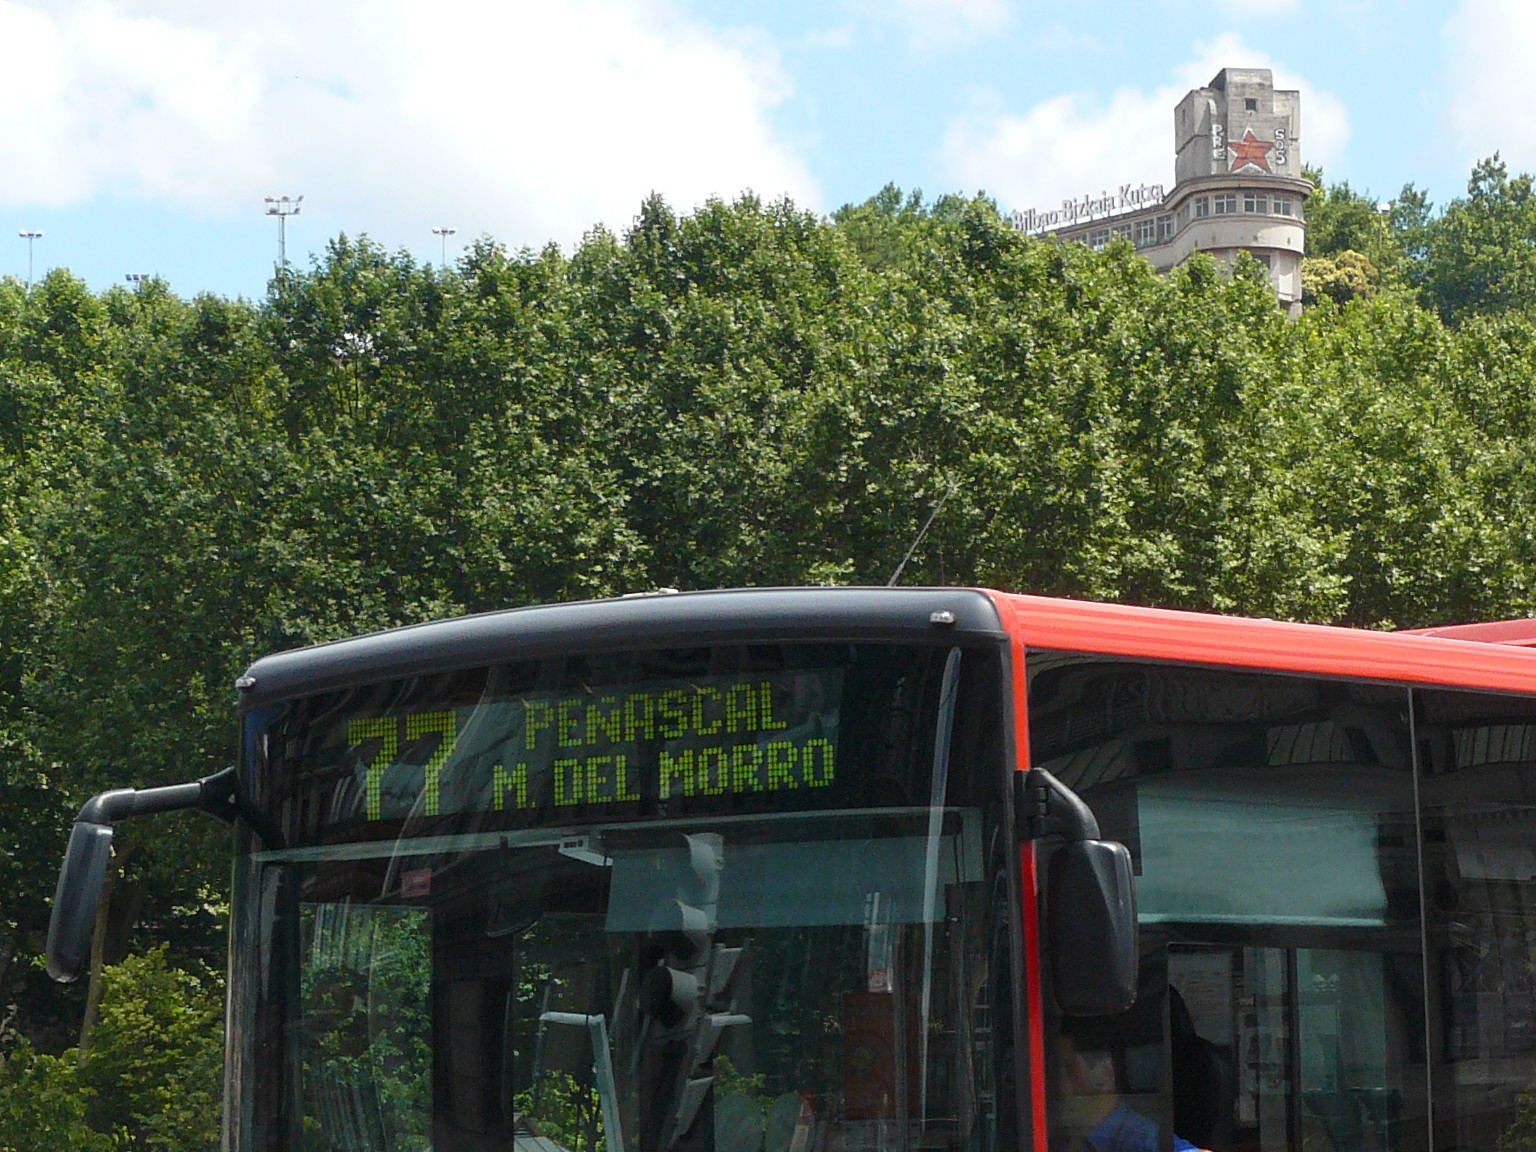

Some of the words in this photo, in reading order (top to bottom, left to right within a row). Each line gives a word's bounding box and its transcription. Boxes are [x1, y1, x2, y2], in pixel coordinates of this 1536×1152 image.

[1012, 207, 1060, 233] Bilbao
[1061, 190, 1116, 222] Bizkaia
[1119, 183, 1164, 209] Kutxa
[347, 711, 457, 821] 77
[554, 754, 641, 806] DEL
[659, 738, 834, 799] MORRO
